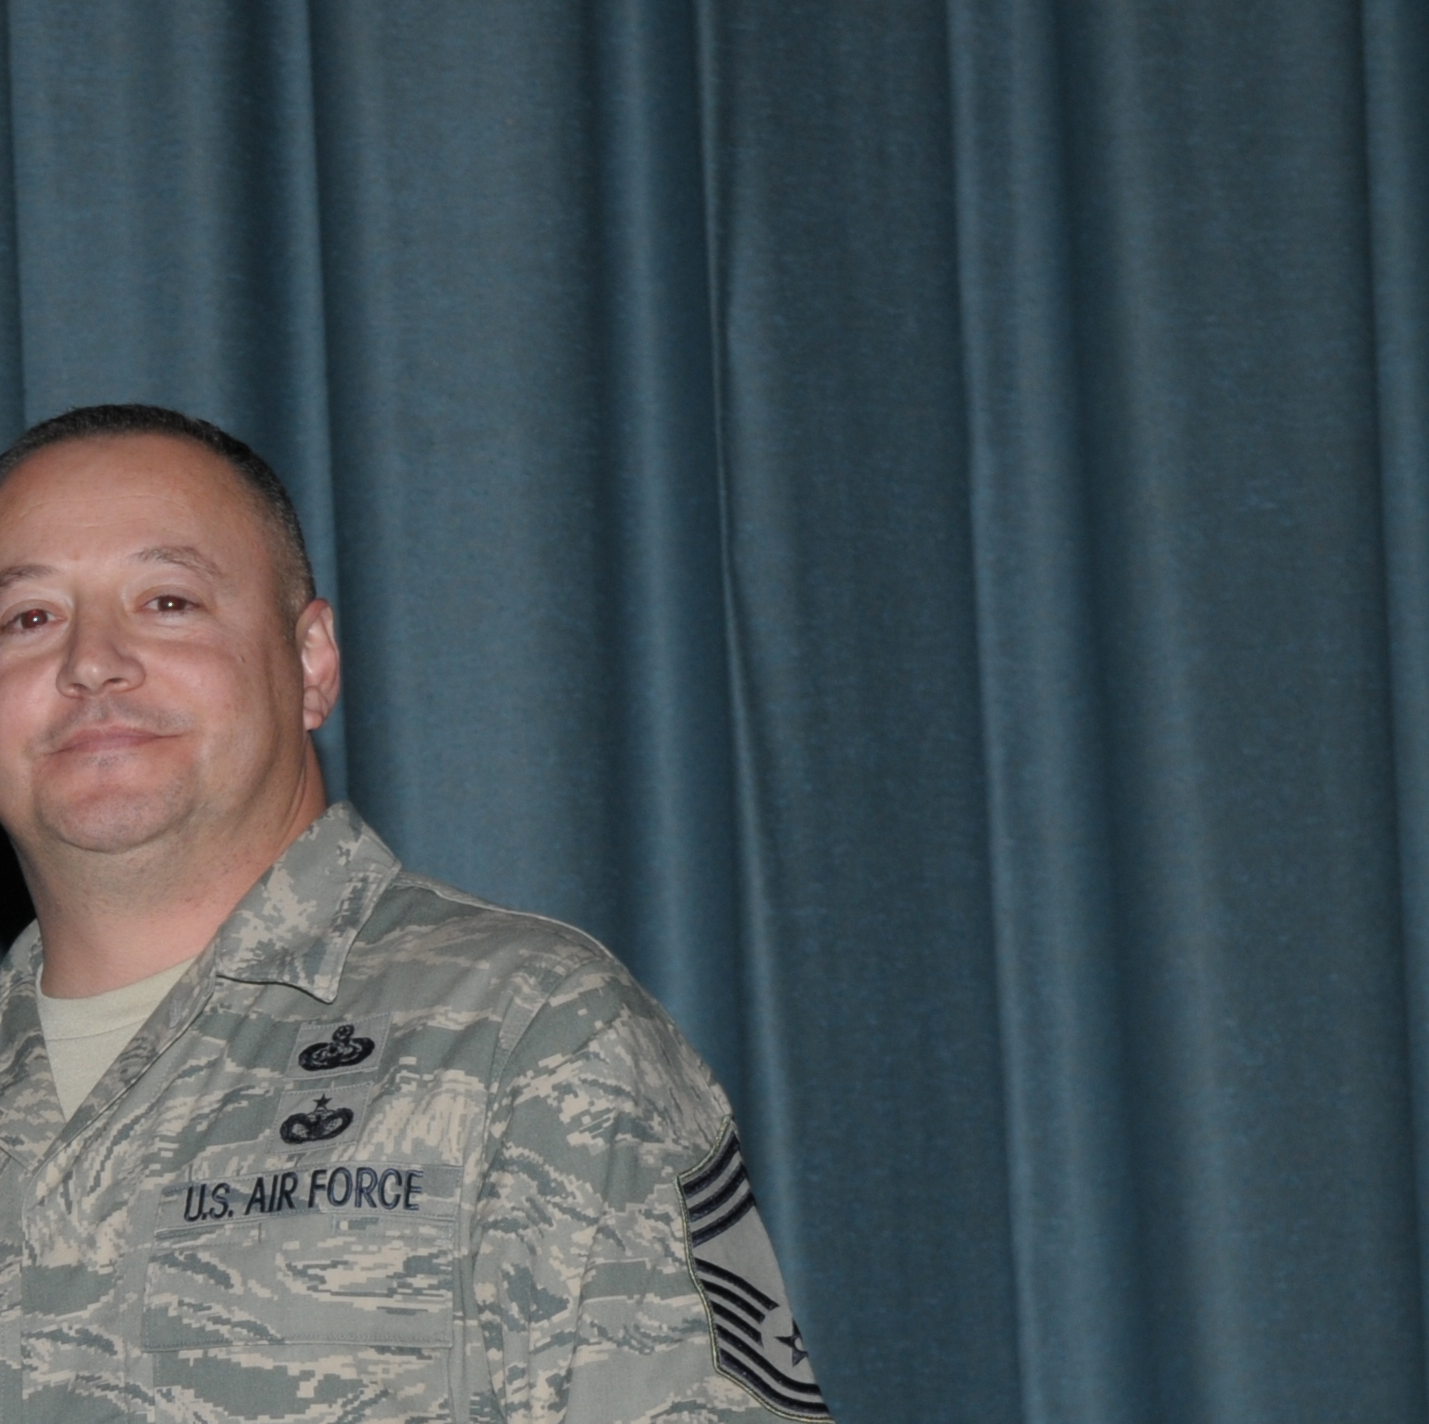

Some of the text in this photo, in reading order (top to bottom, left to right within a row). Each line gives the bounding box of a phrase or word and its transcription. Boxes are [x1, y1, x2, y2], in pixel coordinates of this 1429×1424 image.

[183, 1166, 425, 1221] U.S. AIR FORCE
